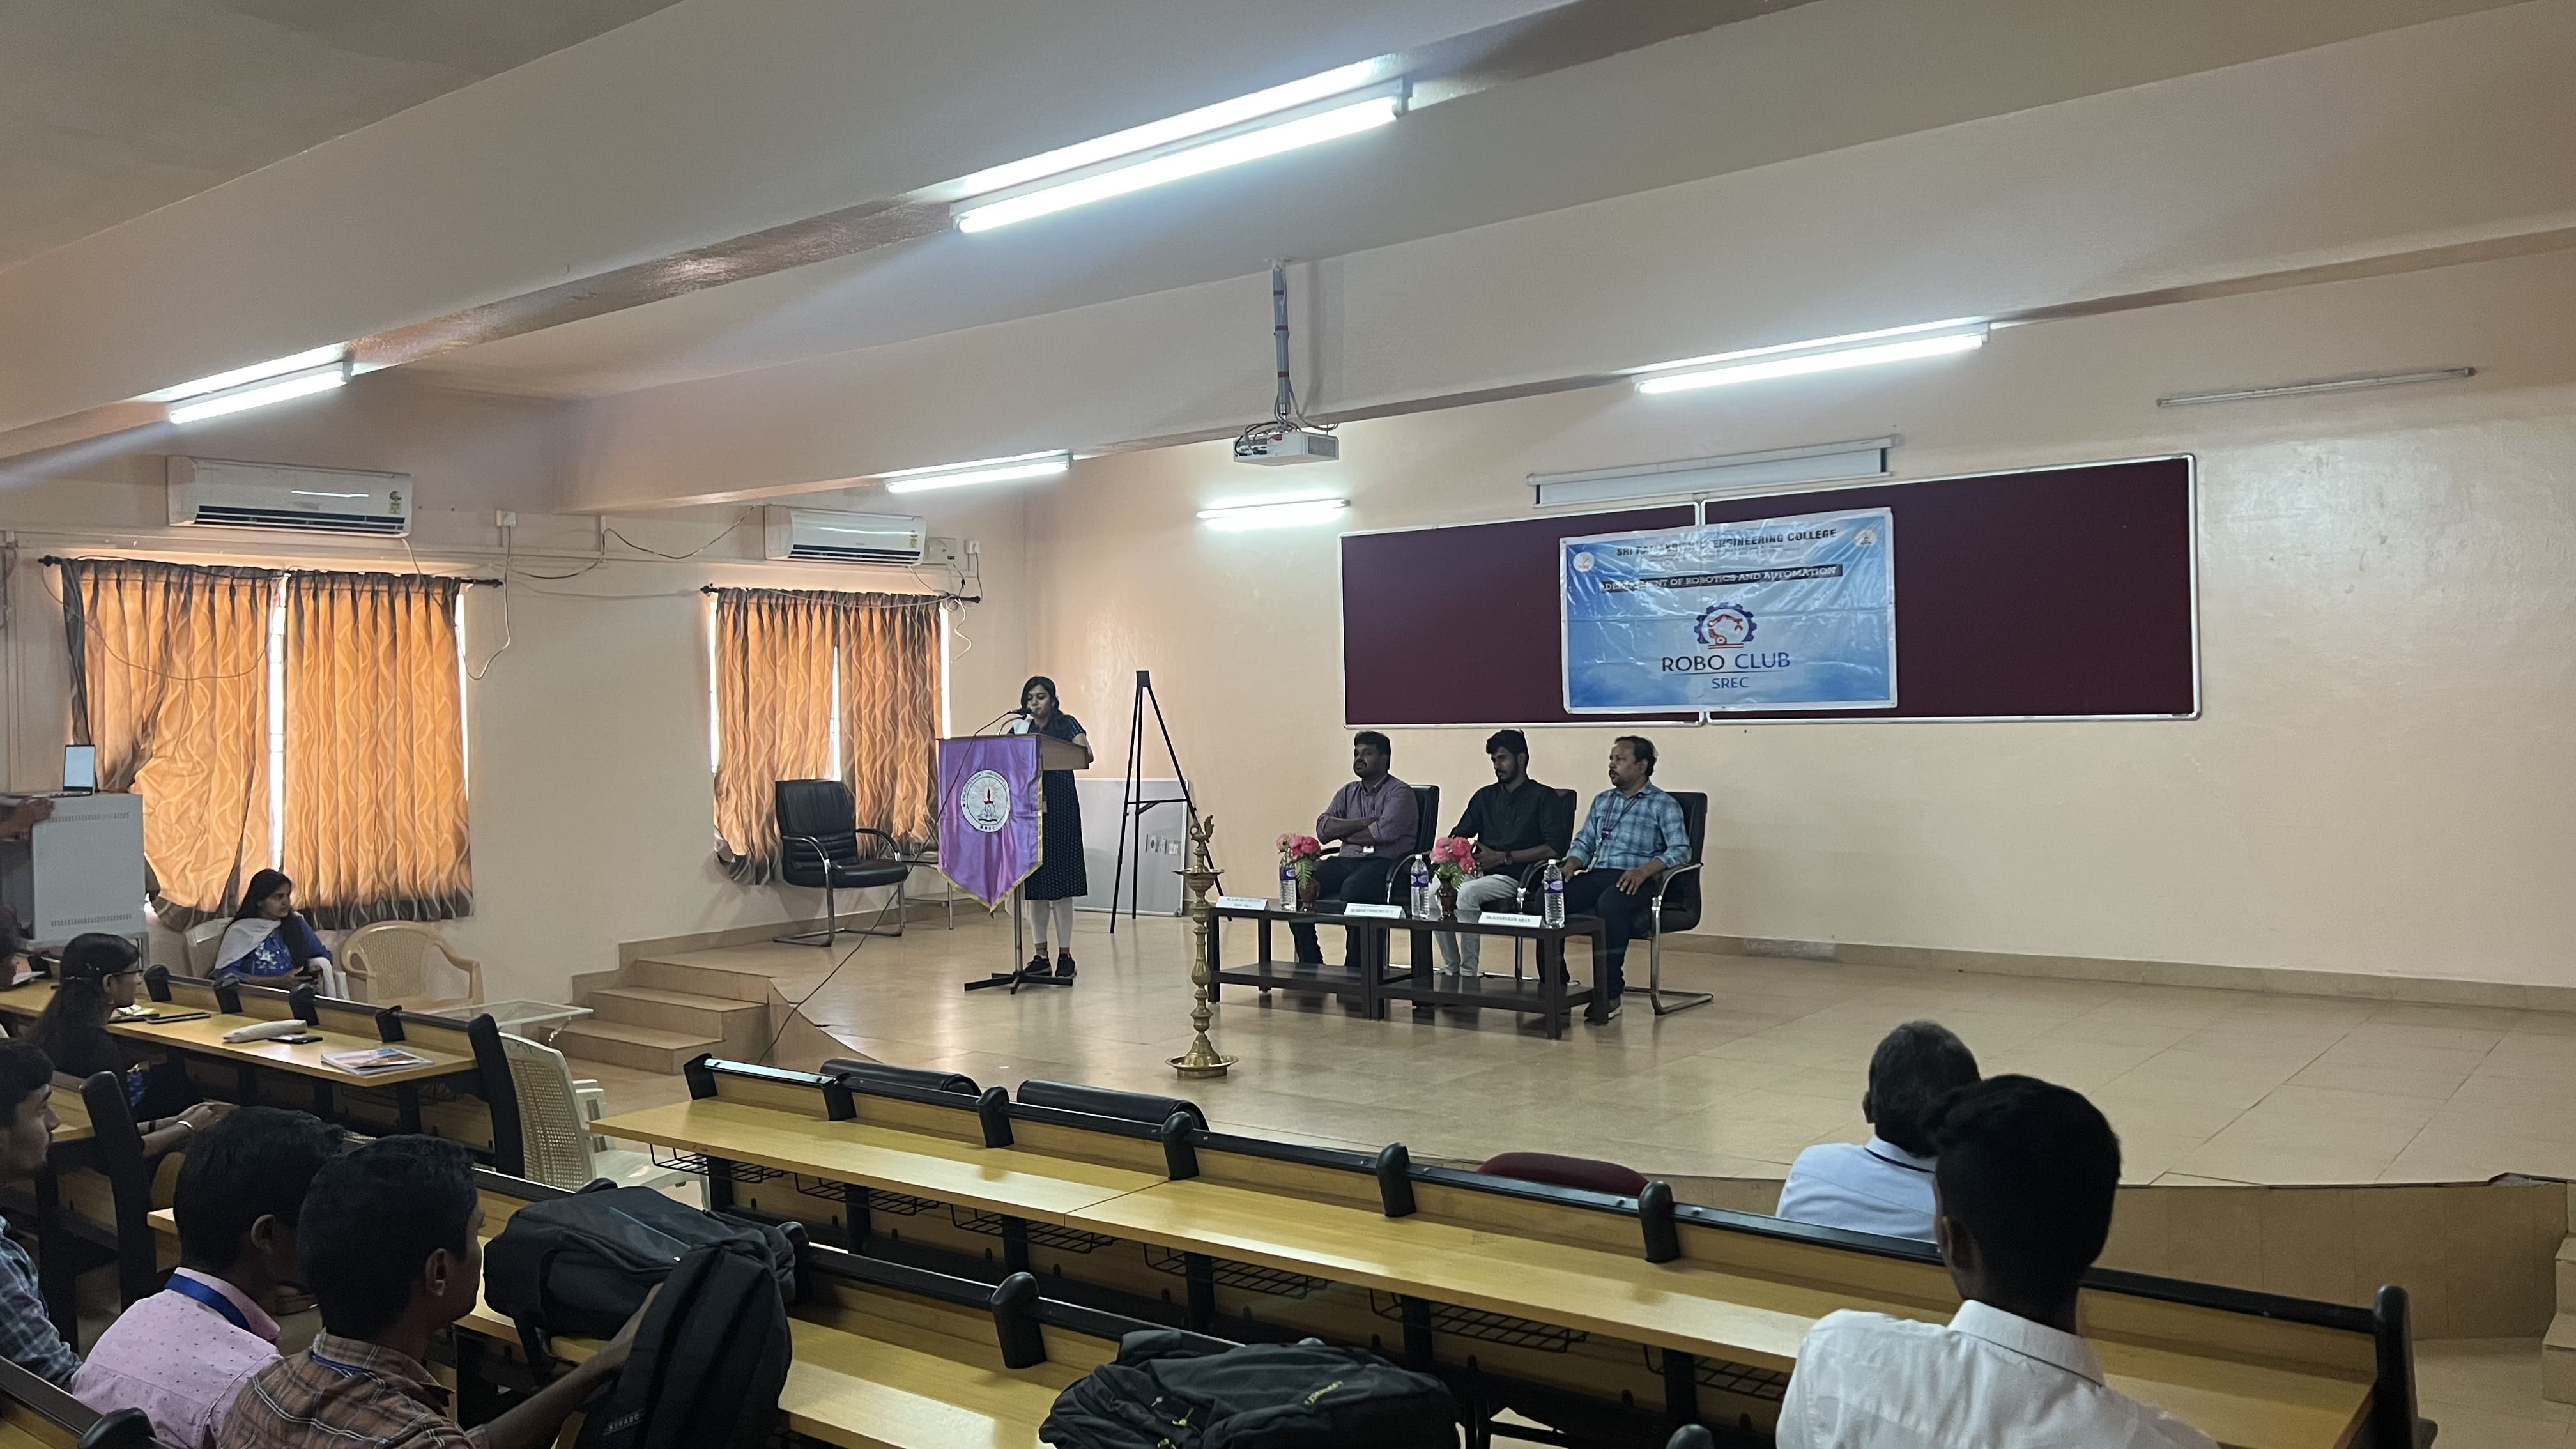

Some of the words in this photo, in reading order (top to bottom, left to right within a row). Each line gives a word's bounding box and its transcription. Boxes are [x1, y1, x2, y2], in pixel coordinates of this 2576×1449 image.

[1617, 547, 1632, 556] SRI
[1788, 528, 1837, 542] COLLEGE
[1670, 578, 1684, 586] OF
[1685, 574, 1736, 585] ROBOTICS
[1738, 572, 1760, 582] AND
[1763, 566, 1837, 581] AUTOMATION
[1662, 655, 1725, 671] ROBO
[1735, 652, 1790, 670] CLUB
[1712, 677, 1749, 689] SREC
